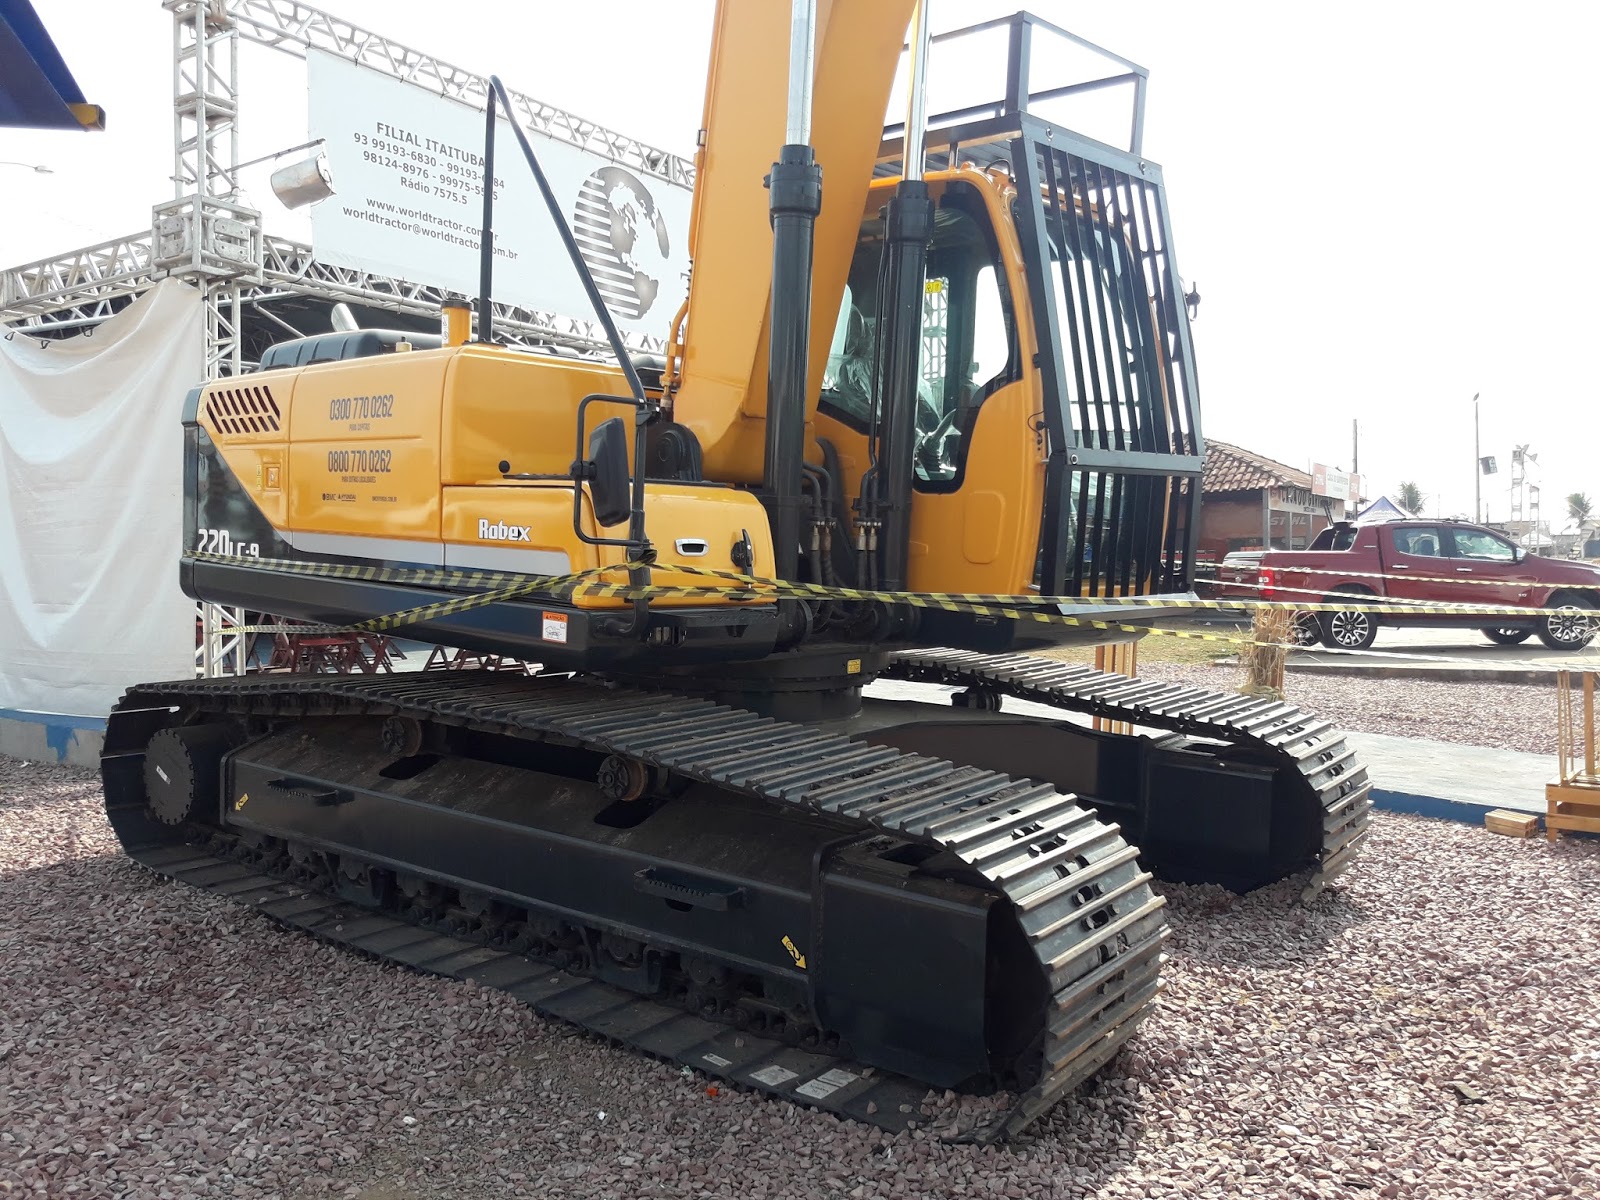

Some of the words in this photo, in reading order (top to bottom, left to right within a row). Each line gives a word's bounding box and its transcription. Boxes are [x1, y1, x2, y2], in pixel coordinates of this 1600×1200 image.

[353, 132, 368, 145] 93
[371, 138, 437, 167] 99193-6830
[447, 162, 505, 189] 99193-84
[376, 121, 422, 148] FILIAL
[425, 138, 485, 167] ITAITUBA
[363, 150, 429, 179] 98124-8976
[439, 174, 498, 201] 99975-555
[400, 176, 430, 194] Rádio
[433, 186, 468, 205] 7575.5
[342, 206, 518, 260] worldtractor@worldtractoom.br
[366, 198, 499, 241] www.worldtractor.cor
[329, 398, 352, 421] 0300
[353, 396, 370, 419] 770
[370, 394, 394, 418] 0262
[328, 450, 349, 473] 0800
[350, 450, 367, 473] 770
[368, 449, 392, 473] 0262
[478, 518, 532, 542] Robex
[1270, 516, 1306, 526] STHL
